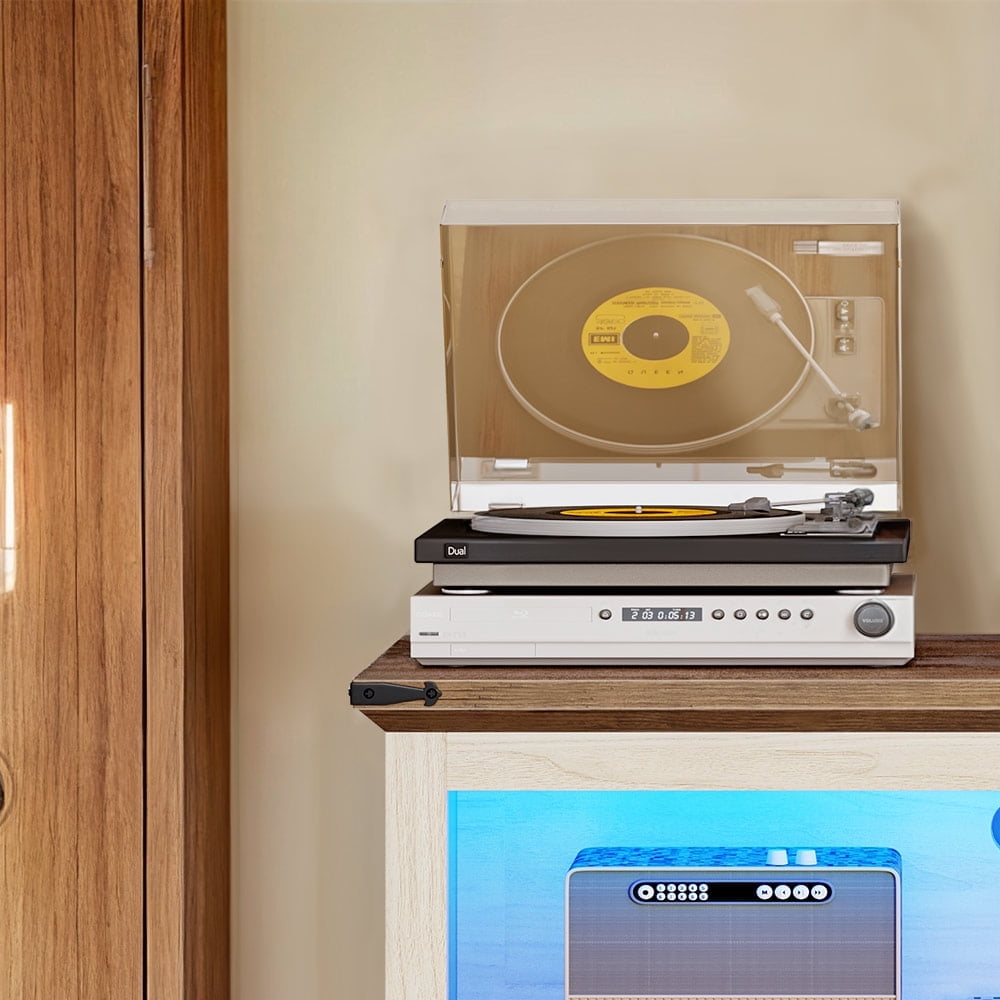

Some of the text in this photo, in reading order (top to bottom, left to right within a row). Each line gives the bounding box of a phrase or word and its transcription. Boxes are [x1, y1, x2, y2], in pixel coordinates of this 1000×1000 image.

[447, 545, 467, 556] Dual
[631, 611, 638, 620] 2
[641, 611, 653, 620] 03
